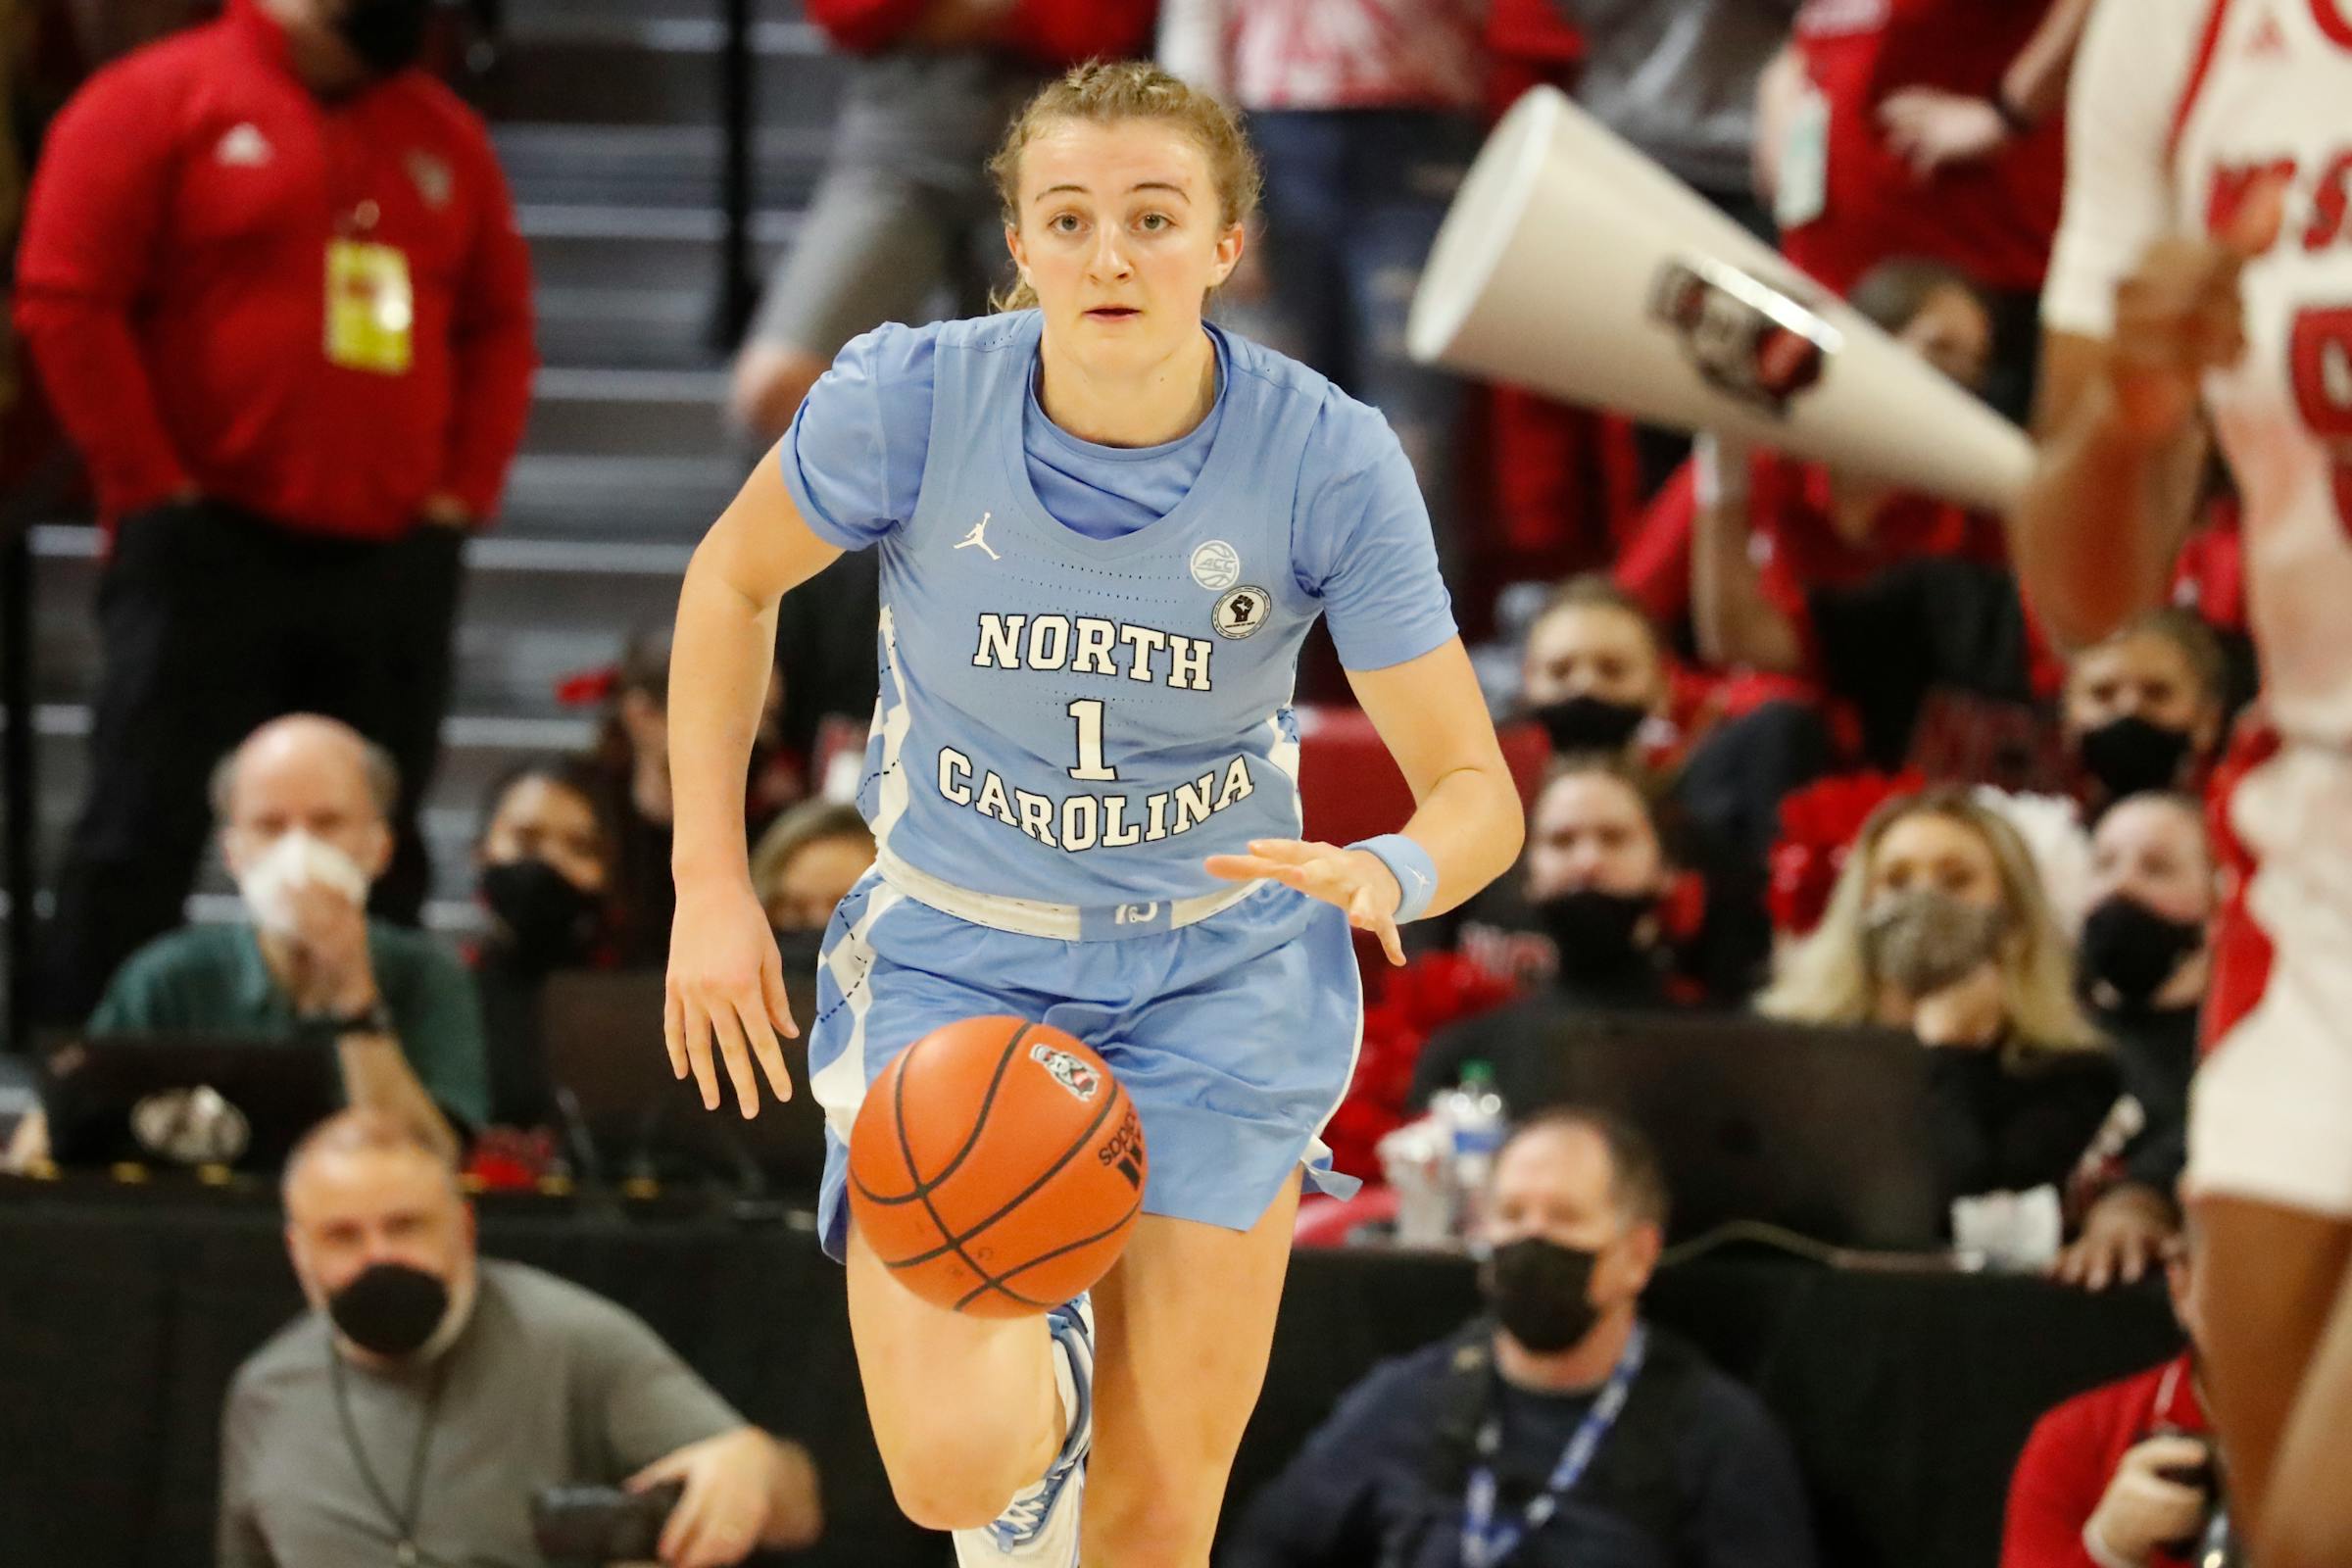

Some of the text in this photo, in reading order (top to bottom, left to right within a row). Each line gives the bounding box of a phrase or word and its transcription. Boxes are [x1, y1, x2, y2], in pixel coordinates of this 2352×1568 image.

[1198, 558, 1238, 574] ACC
[972, 612, 1213, 691] NORTH
[1066, 698, 1118, 781] 1
[937, 746, 1255, 853] CAROLINA
